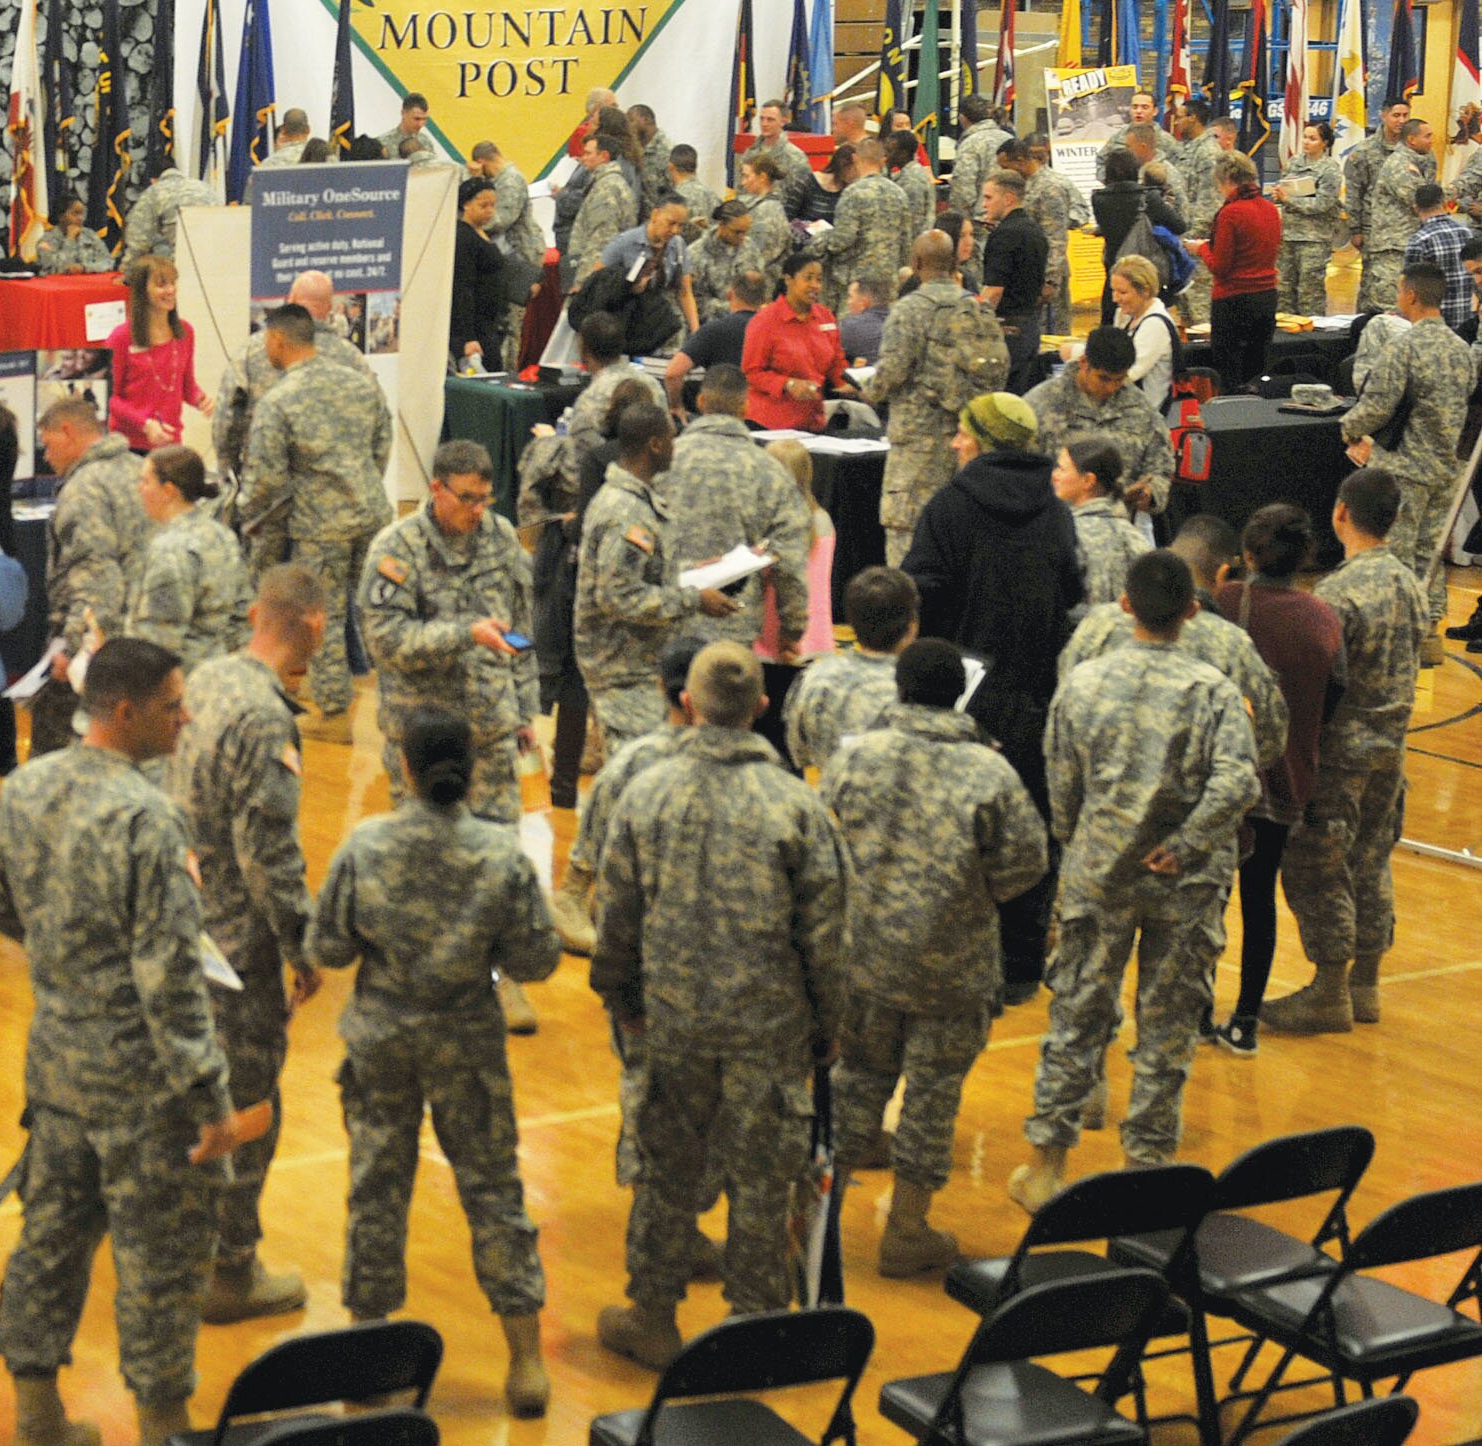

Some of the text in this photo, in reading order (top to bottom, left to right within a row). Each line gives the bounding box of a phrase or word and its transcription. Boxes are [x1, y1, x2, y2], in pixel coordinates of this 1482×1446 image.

[377, 8, 648, 50] MOUNTAIN
[455, 57, 580, 98] POST
[1061, 68, 1106, 98] READY
[1056, 147, 1098, 158] WINTER
[262, 187, 400, 207] Military OneSource
[350, 237, 385, 249] National
[294, 256, 309, 267] and
[339, 253, 375, 264] members
[376, 252, 392, 262] and
